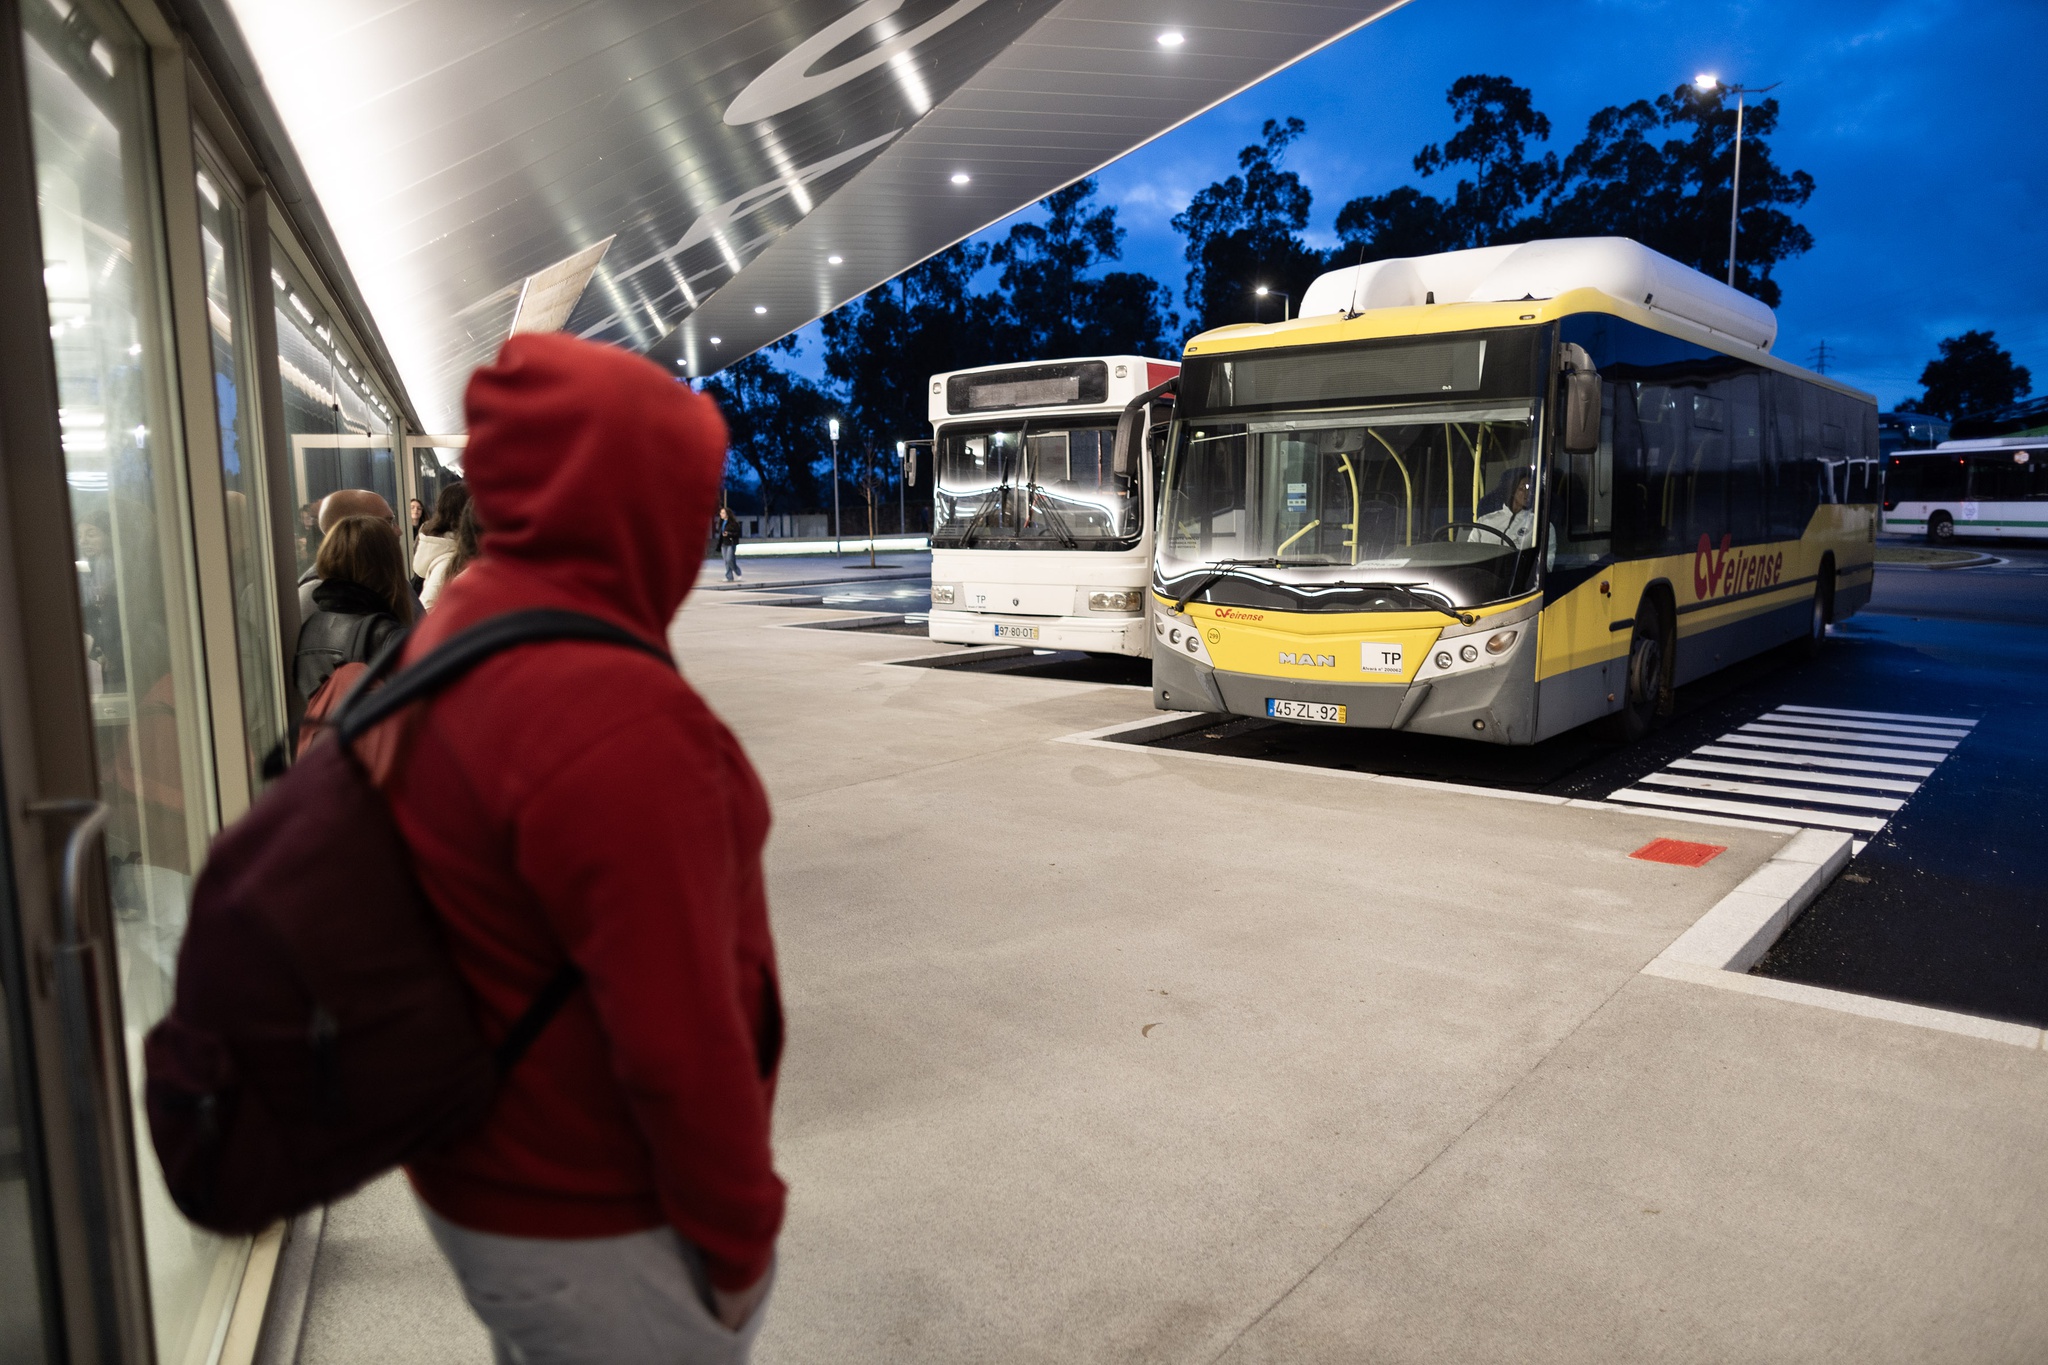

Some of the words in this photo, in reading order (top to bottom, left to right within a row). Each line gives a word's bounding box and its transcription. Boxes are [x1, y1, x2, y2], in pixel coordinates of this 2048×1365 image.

[976, 595, 986, 604] TP
[1279, 652, 1336, 667] MAN
[1381, 651, 1402, 665] TP
